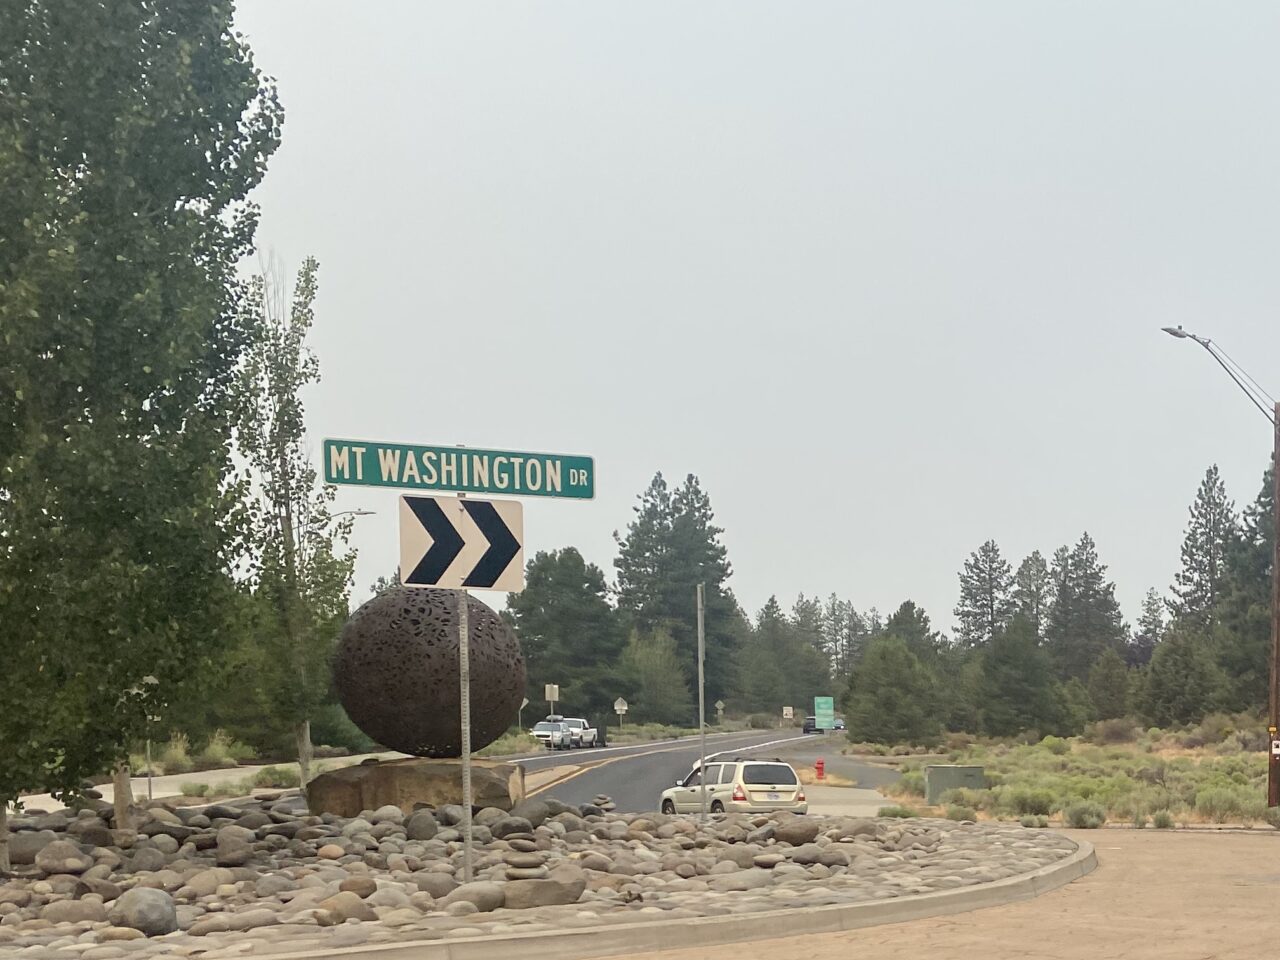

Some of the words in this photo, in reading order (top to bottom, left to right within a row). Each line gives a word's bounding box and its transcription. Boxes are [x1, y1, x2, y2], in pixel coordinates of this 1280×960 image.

[330, 445, 366, 480] MT
[378, 448, 562, 492] WASHINGTON
[569, 468, 588, 486] DR
